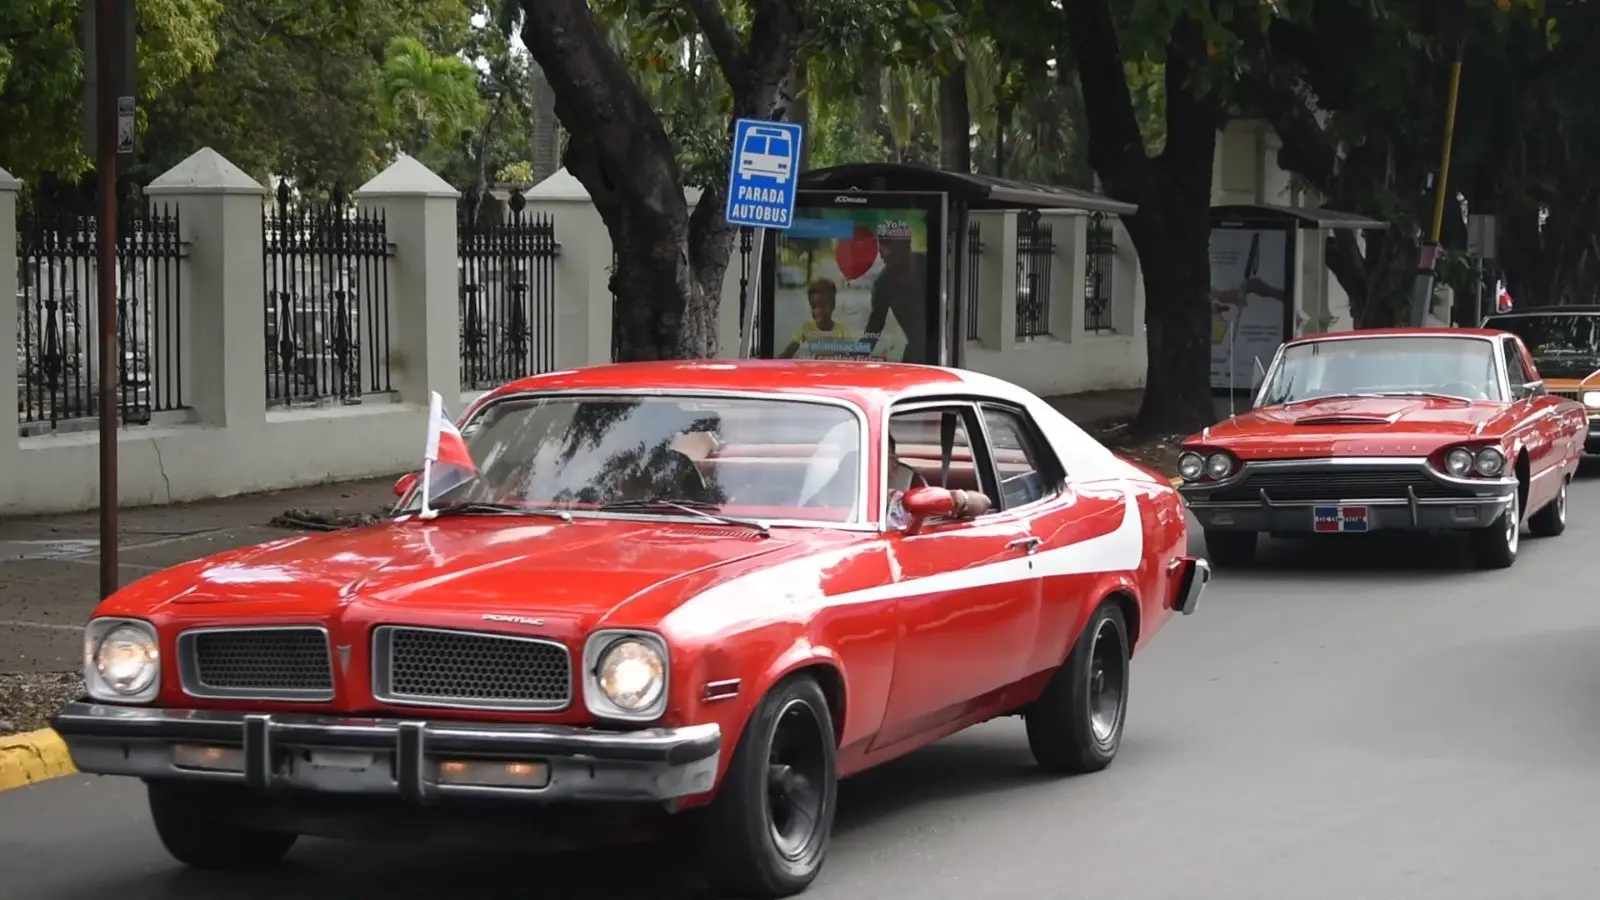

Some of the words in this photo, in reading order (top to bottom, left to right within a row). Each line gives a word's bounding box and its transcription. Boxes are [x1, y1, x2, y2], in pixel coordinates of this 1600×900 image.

[738, 185, 785, 204] PARADA
[731, 203, 788, 223] AUTOBUS
[482, 613, 545, 626] PONTIAC
